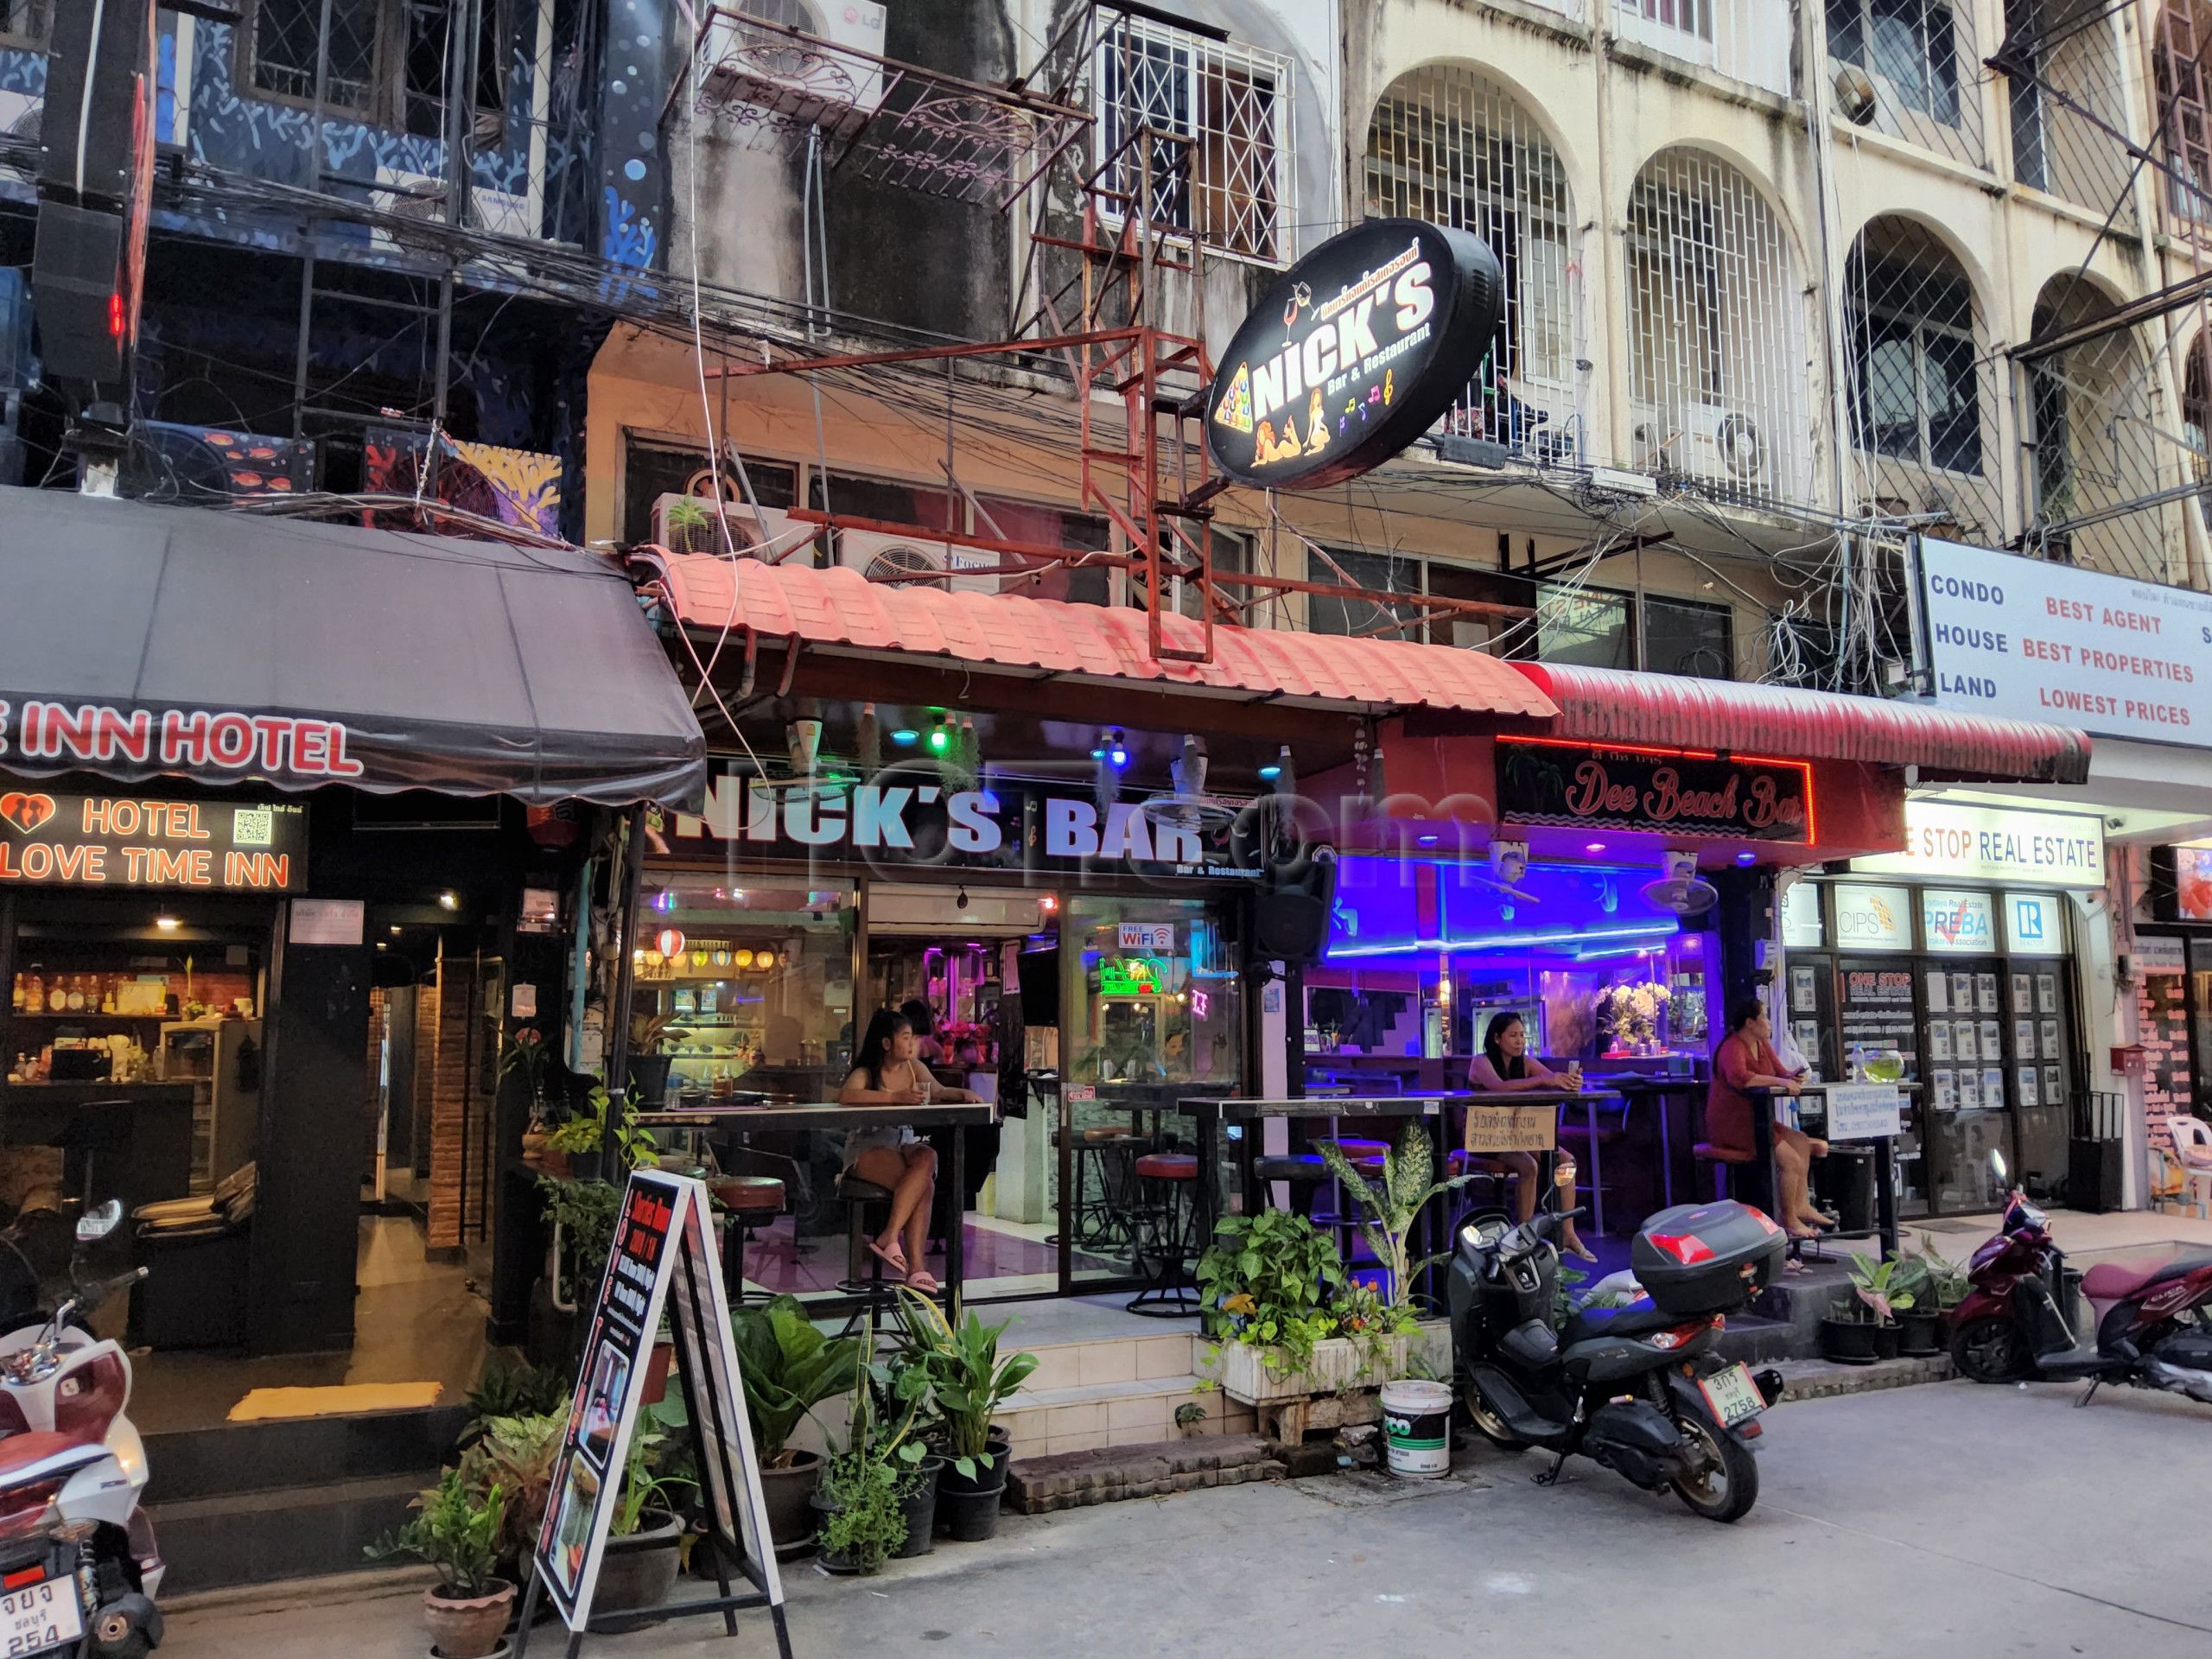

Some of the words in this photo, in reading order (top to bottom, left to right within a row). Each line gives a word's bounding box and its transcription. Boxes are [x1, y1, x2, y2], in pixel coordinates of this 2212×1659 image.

[862, 14, 880, 30] LG
[481, 194, 525, 209] SAMSUNG
[1252, 261, 1435, 423] NICK'S
[1326, 375, 1348, 397] Bar
[1351, 368, 1361, 383] &
[1363, 321, 1433, 372] Restaurant
[1930, 574, 2005, 606] CONDO
[2045, 596, 2094, 622] BEST
[2102, 607, 2162, 635] AGENT
[1936, 623, 2008, 653] HOUSE
[2023, 638, 2073, 664] BEST
[2080, 648, 2195, 683] PROPERTIES
[1940, 672, 1997, 699] LAND
[2039, 687, 2118, 716] LOWEST
[2125, 700, 2191, 727] PRICES
[20, 700, 153, 764] INN
[160, 709, 365, 778] HOTEL
[1566, 761, 1639, 816] Dee
[1643, 766, 1739, 821] Beach
[1742, 775, 1802, 828] Bar
[82, 798, 211, 839] HOTEL
[674, 775, 1003, 853] NICK'S
[1045, 797, 1204, 864] BAR
[1923, 827, 1972, 860] STOP
[1979, 831, 2027, 863] REAL
[2034, 836, 2097, 868] ESTATE
[0, 842, 108, 881] LOVE
[121, 846, 213, 885] TIME
[224, 850, 290, 888] INN
[1176, 864, 1194, 874] Bar
[1197, 866, 1205, 874] &
[1208, 865, 1264, 878] Restaurant
[1839, 911, 1879, 934] CIPS
[1925, 911, 1988, 936] PREBA
[1122, 932, 1154, 946] WiFi
[1849, 972, 1877, 986] ONE
[1878, 972, 1911, 986] STOP
[1851, 985, 1876, 996] REAL
[1878, 986, 1911, 996] ESTATE
[1724, 1395, 1756, 1420] 2758
[15, 1609, 48, 1630] ชลบุรี
[8, 1624, 60, 1656] 254
